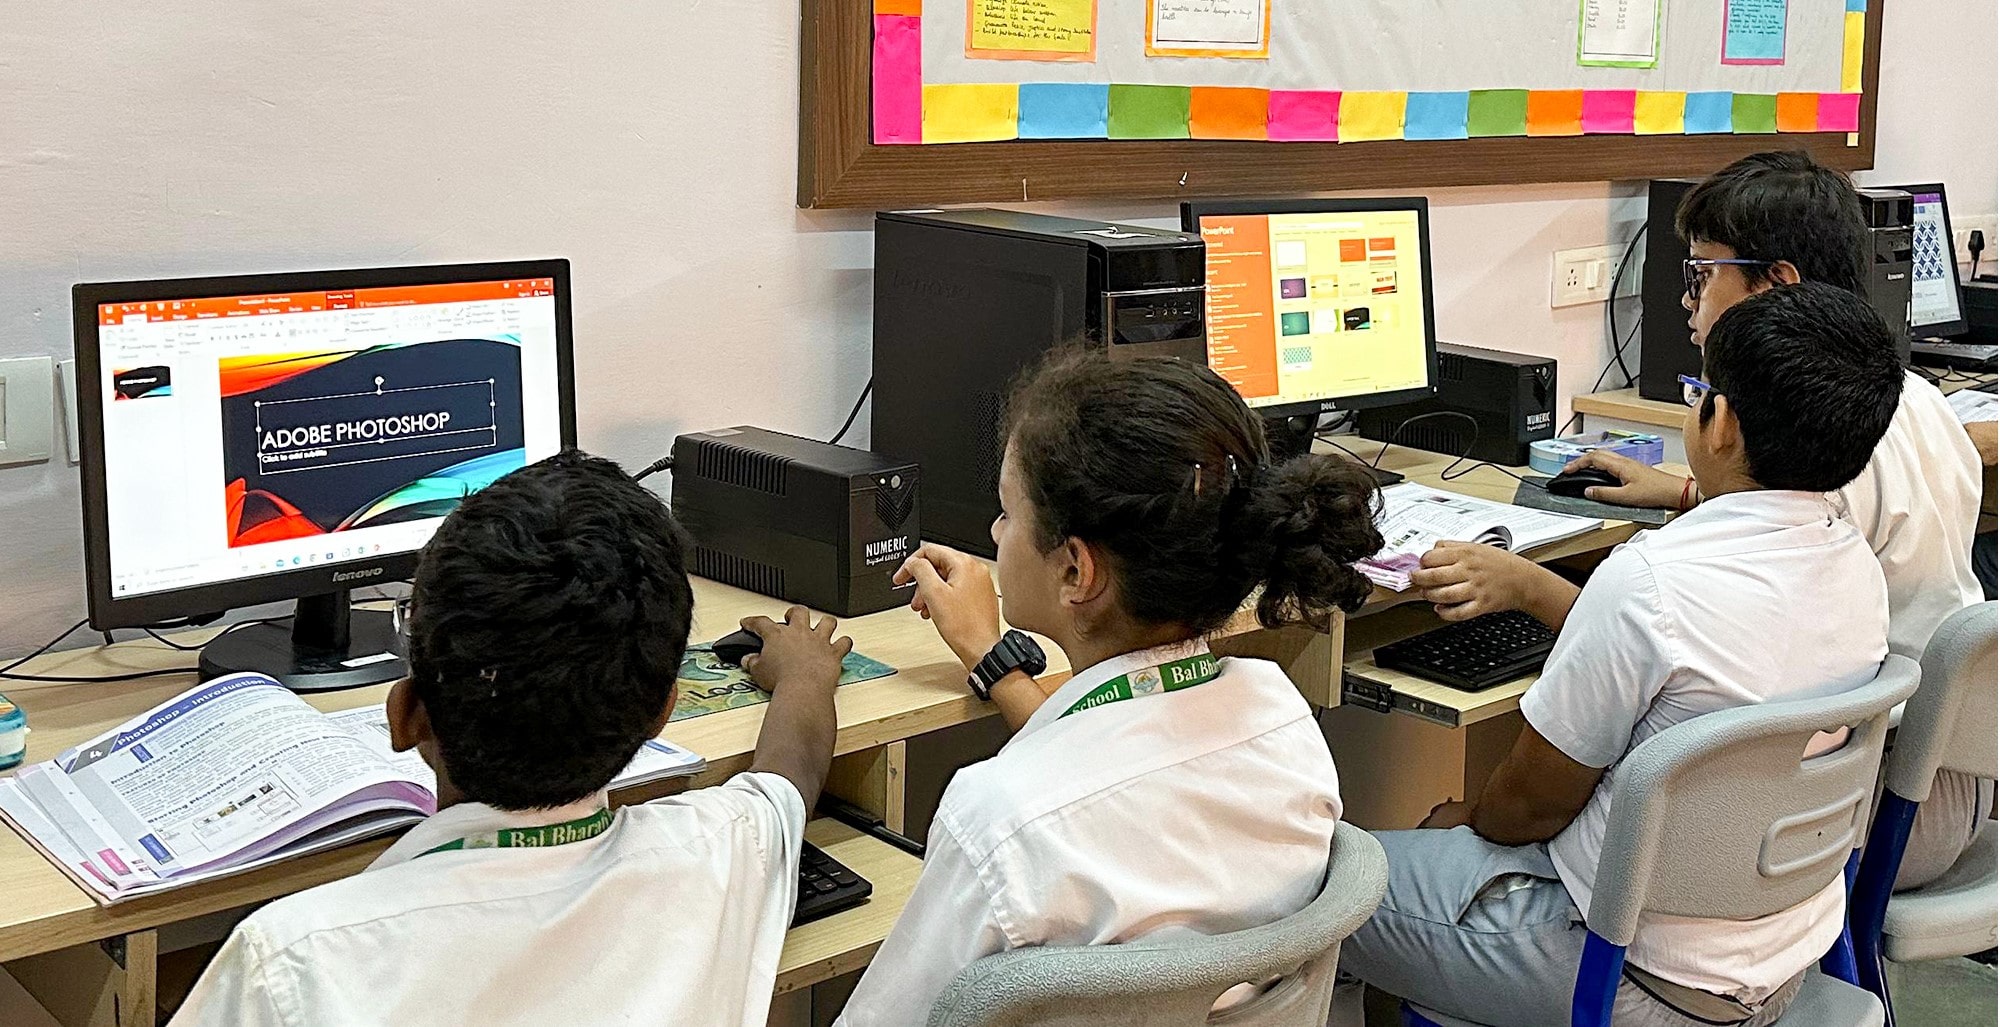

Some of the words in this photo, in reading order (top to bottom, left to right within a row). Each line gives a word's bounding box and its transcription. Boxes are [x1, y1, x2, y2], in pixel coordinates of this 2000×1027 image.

[1321, 402, 1337, 411] DELL
[1527, 411, 1551, 425] NUMERIC
[262, 423, 333, 450] ADOBE
[336, 411, 450, 442] PHOTOSHOP
[866, 536, 908, 558] NUMERIC
[332, 567, 384, 583] lenovo
[1171, 662, 1198, 685] Bal
[117, 709, 180, 746] Photoshop
[191, 679, 266, 706] Introduction
[510, 830, 545, 848] Bal
